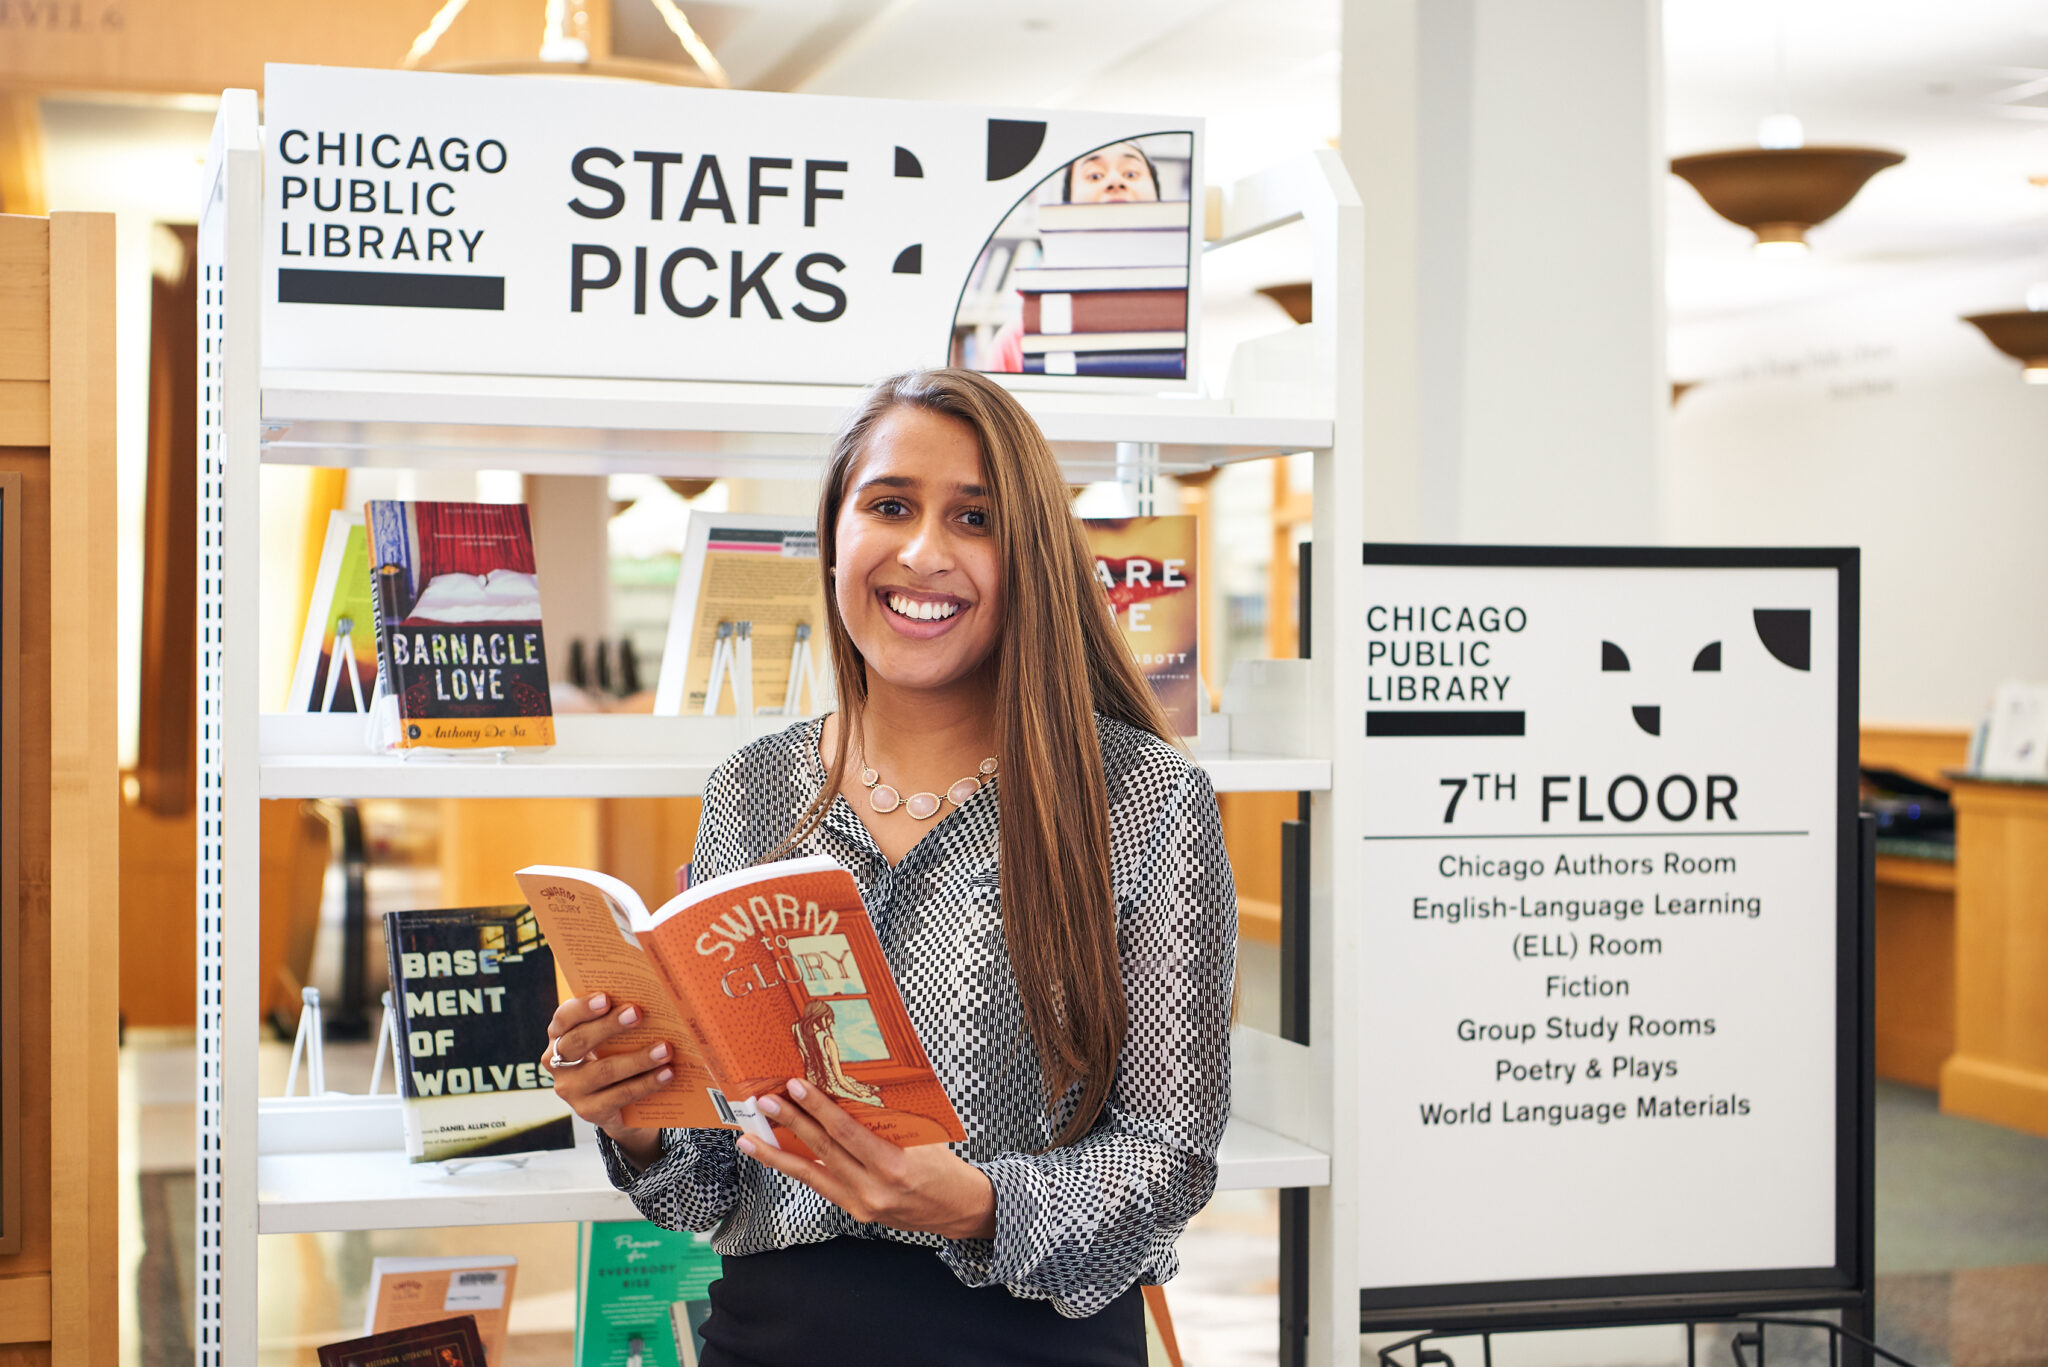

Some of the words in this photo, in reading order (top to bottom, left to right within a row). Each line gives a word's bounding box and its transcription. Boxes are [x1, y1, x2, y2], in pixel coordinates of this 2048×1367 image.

[279, 129, 508, 174] CHICAGO
[281, 175, 456, 217] PUBLIC
[567, 146, 849, 228] STAFF
[281, 221, 485, 263] LIBRARY
[570, 243, 848, 324] PICKS
[1366, 606, 1527, 632] CHICAGO
[392, 633, 540, 665] BARNACLE
[1368, 641, 1490, 667] PUBLIC
[435, 668, 504, 701] LOVE
[1368, 675, 1510, 702] LIBRARY
[427, 726, 481, 742] Anthony
[1439, 773, 1516, 824] 7TH
[1541, 773, 1739, 823] FLOOR
[1438, 854, 1545, 881] Chicago
[1554, 853, 1654, 876] Authors
[1664, 852, 1736, 874] Room
[1413, 895, 1644, 923] English-Language
[1655, 893, 1761, 919] Learning
[695, 893, 839, 962] SWARM
[760, 935, 789, 950] to
[1512, 933, 1578, 960] (ELL)
[1589, 933, 1662, 956] Room
[721, 949, 850, 998] GLORY
[1546, 975, 1630, 998] Fiction
[406, 986, 506, 1018] MENT
[409, 1029, 454, 1057] OF
[1457, 1018, 1537, 1044] Group
[1546, 1015, 1619, 1042] Study
[1628, 1014, 1716, 1038] Rooms
[411, 1062, 554, 1097] WOLVES
[1496, 1059, 1576, 1084] Poetry
[1585, 1058, 1602, 1079] &
[1612, 1056, 1678, 1082] Plays
[1419, 1101, 1492, 1126] World
[1502, 1100, 1627, 1126] Language
[1637, 1093, 1751, 1118] Materials
[440, 1125, 466, 1133] DANIEL
[467, 1123, 489, 1131] ALLEN
